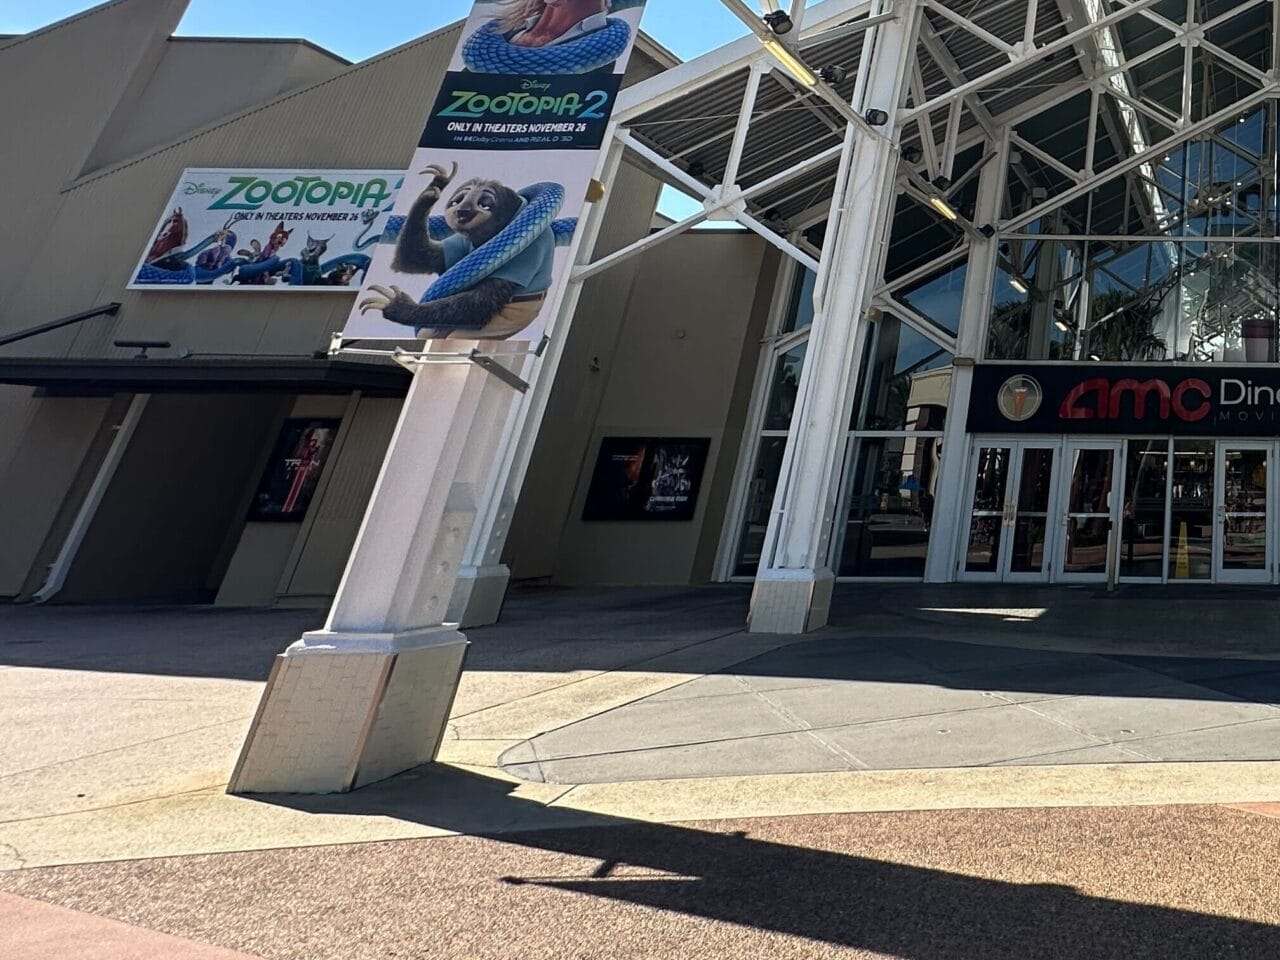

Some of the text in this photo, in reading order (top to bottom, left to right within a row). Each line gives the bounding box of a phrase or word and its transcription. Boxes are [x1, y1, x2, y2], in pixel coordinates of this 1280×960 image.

[520, 79, 551, 91] Disney
[436, 90, 609, 119] ZOOTOPIA 2
[447, 121, 587, 133] ONLY IN THEATERS NOVEMBER 26
[183, 181, 221, 198] Disney
[206, 176, 392, 211] ZOOTOPIA
[234, 212, 359, 221] ONLY IN THEATERS NOVEMBER 26
